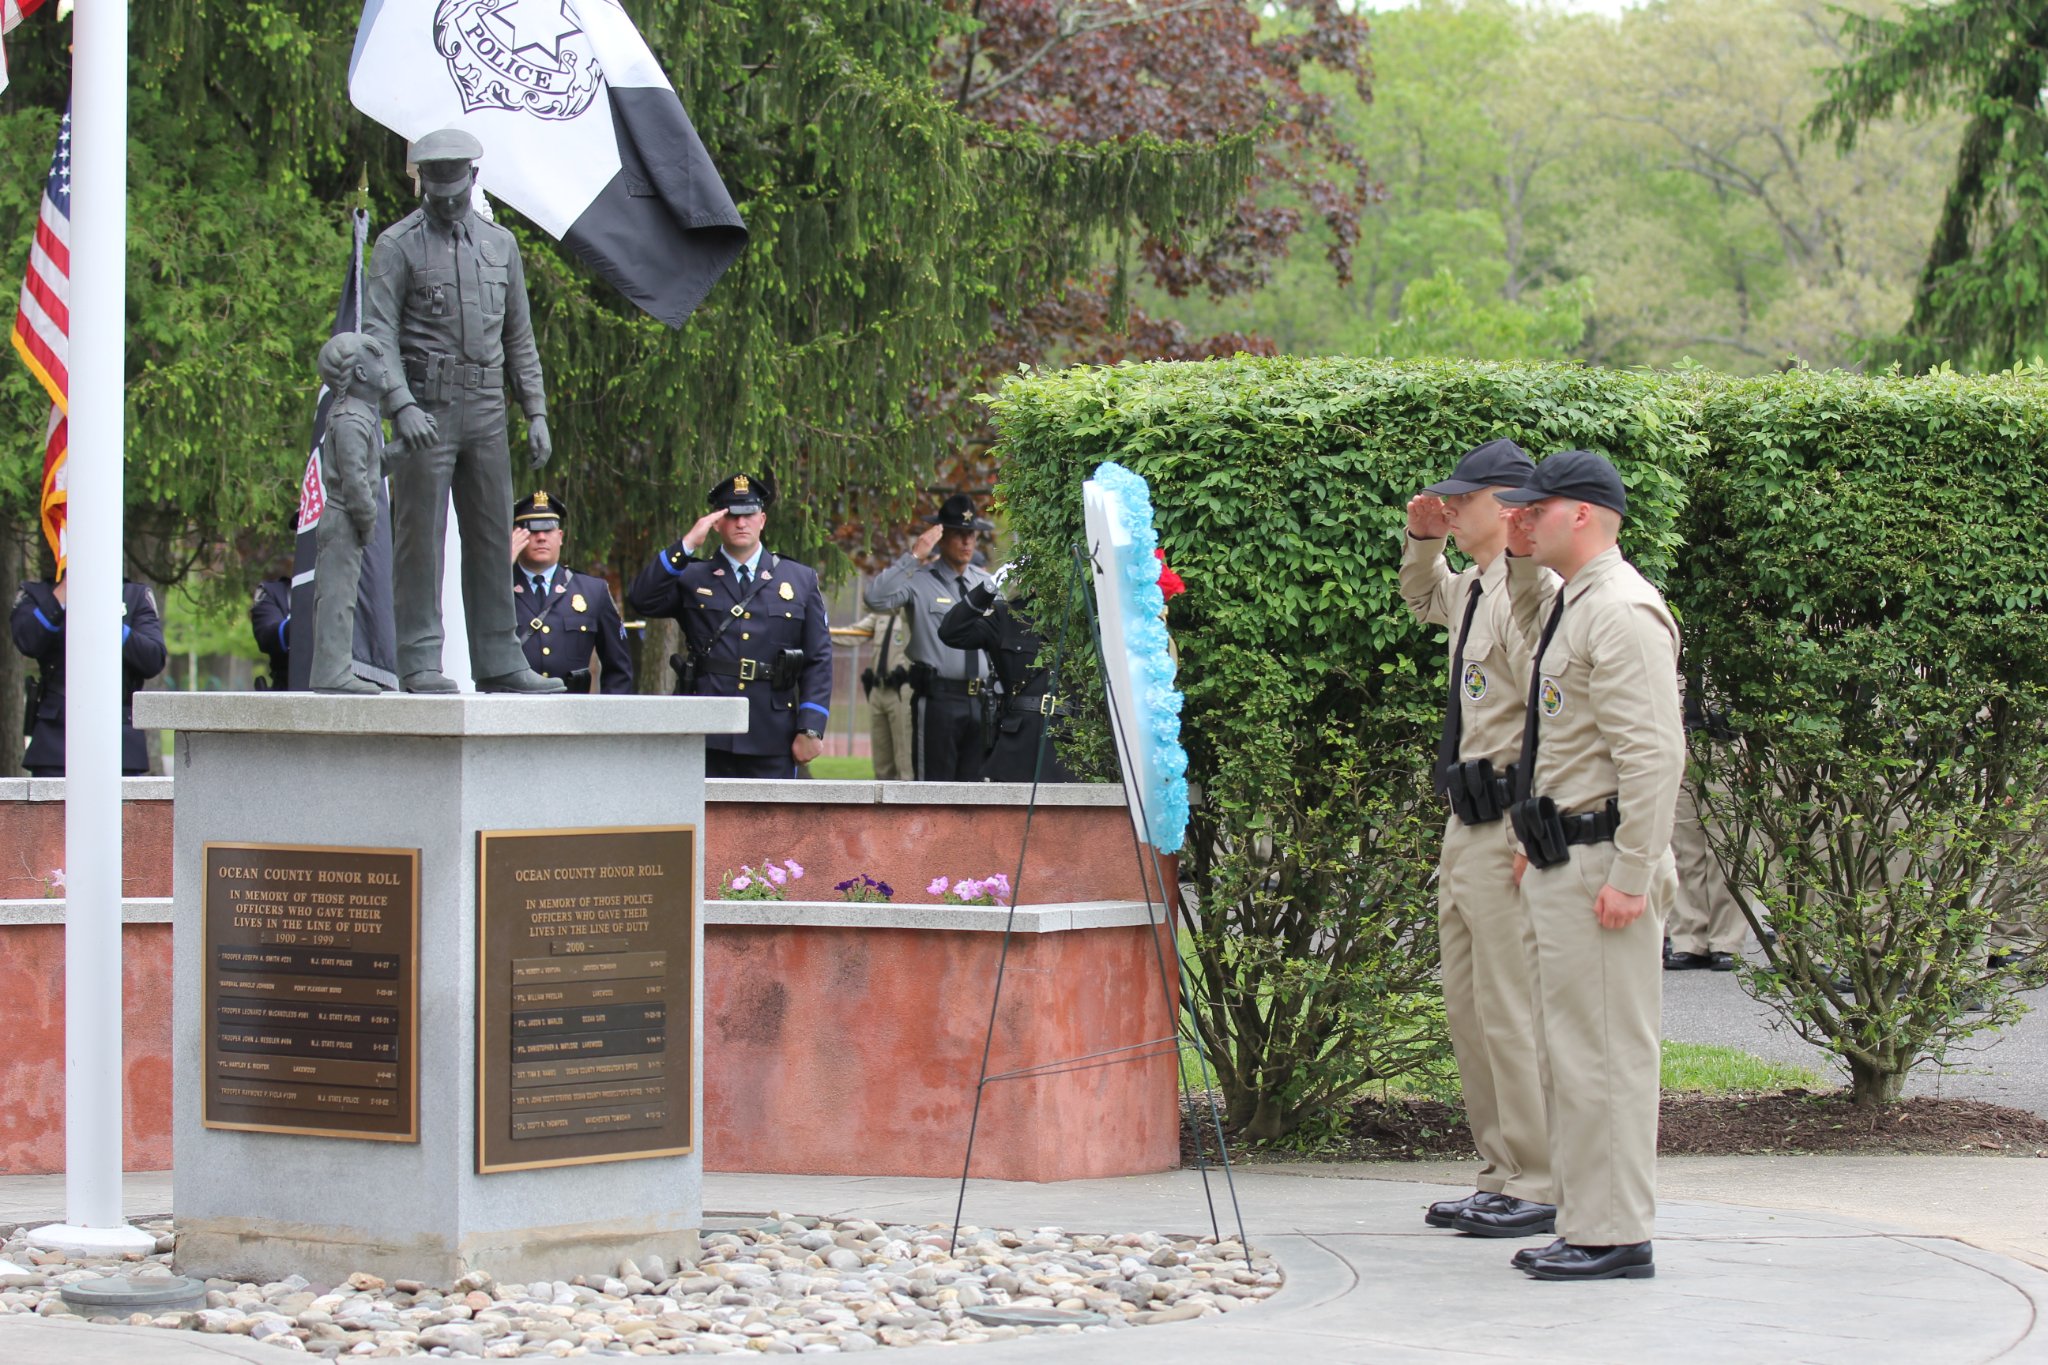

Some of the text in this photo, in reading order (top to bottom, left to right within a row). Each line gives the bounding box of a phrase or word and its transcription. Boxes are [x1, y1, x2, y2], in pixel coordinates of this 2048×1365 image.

[465, 22, 552, 90] POLICE
[218, 866, 401, 886] OCEAN COUNTY HONOR ROLL
[515, 864, 664, 882] OCEAN COUNTY HONOR ROLL
[230, 889, 388, 906] IN MEMORY OF THOSE POLICE
[525, 894, 654, 910] IN MEMORY OF THOSE POLICE
[236, 903, 382, 920] OFFICERS WHO GAVE THEIR
[531, 907, 648, 923] OFFICERS WHO GAVE THEIR
[234, 917, 383, 934] LIVES IN THE LINE OF DUTY
[529, 921, 650, 937] LIVES IN THE LINE OF DUTY
[275, 933, 297, 944] 1900
[313, 935, 335, 946] 1999
[565, 941, 586, 953] 2000
[336, 959, 353, 967] POLICE
